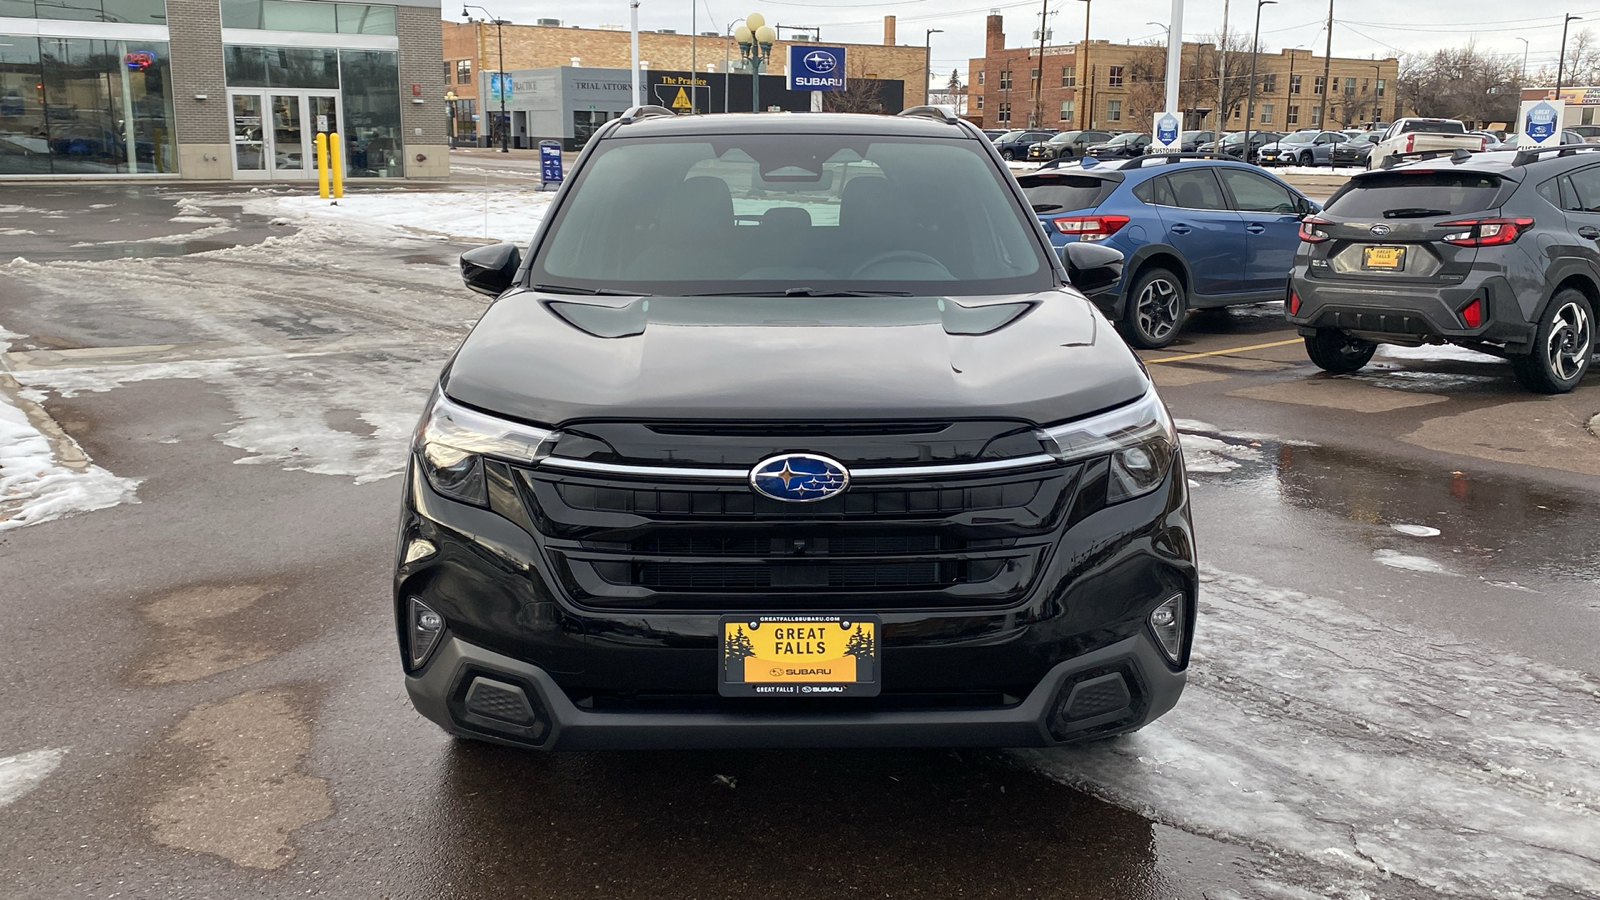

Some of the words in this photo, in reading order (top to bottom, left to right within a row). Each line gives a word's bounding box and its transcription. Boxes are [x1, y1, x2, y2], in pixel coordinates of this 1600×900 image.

[124, 52, 152, 65] OPEN
[662, 75, 676, 84] The
[795, 77, 843, 87] SUBARU
[576, 82, 600, 90] TRIAL
[775, 628, 826, 640] GREAT
[775, 641, 826, 655] FALLS
